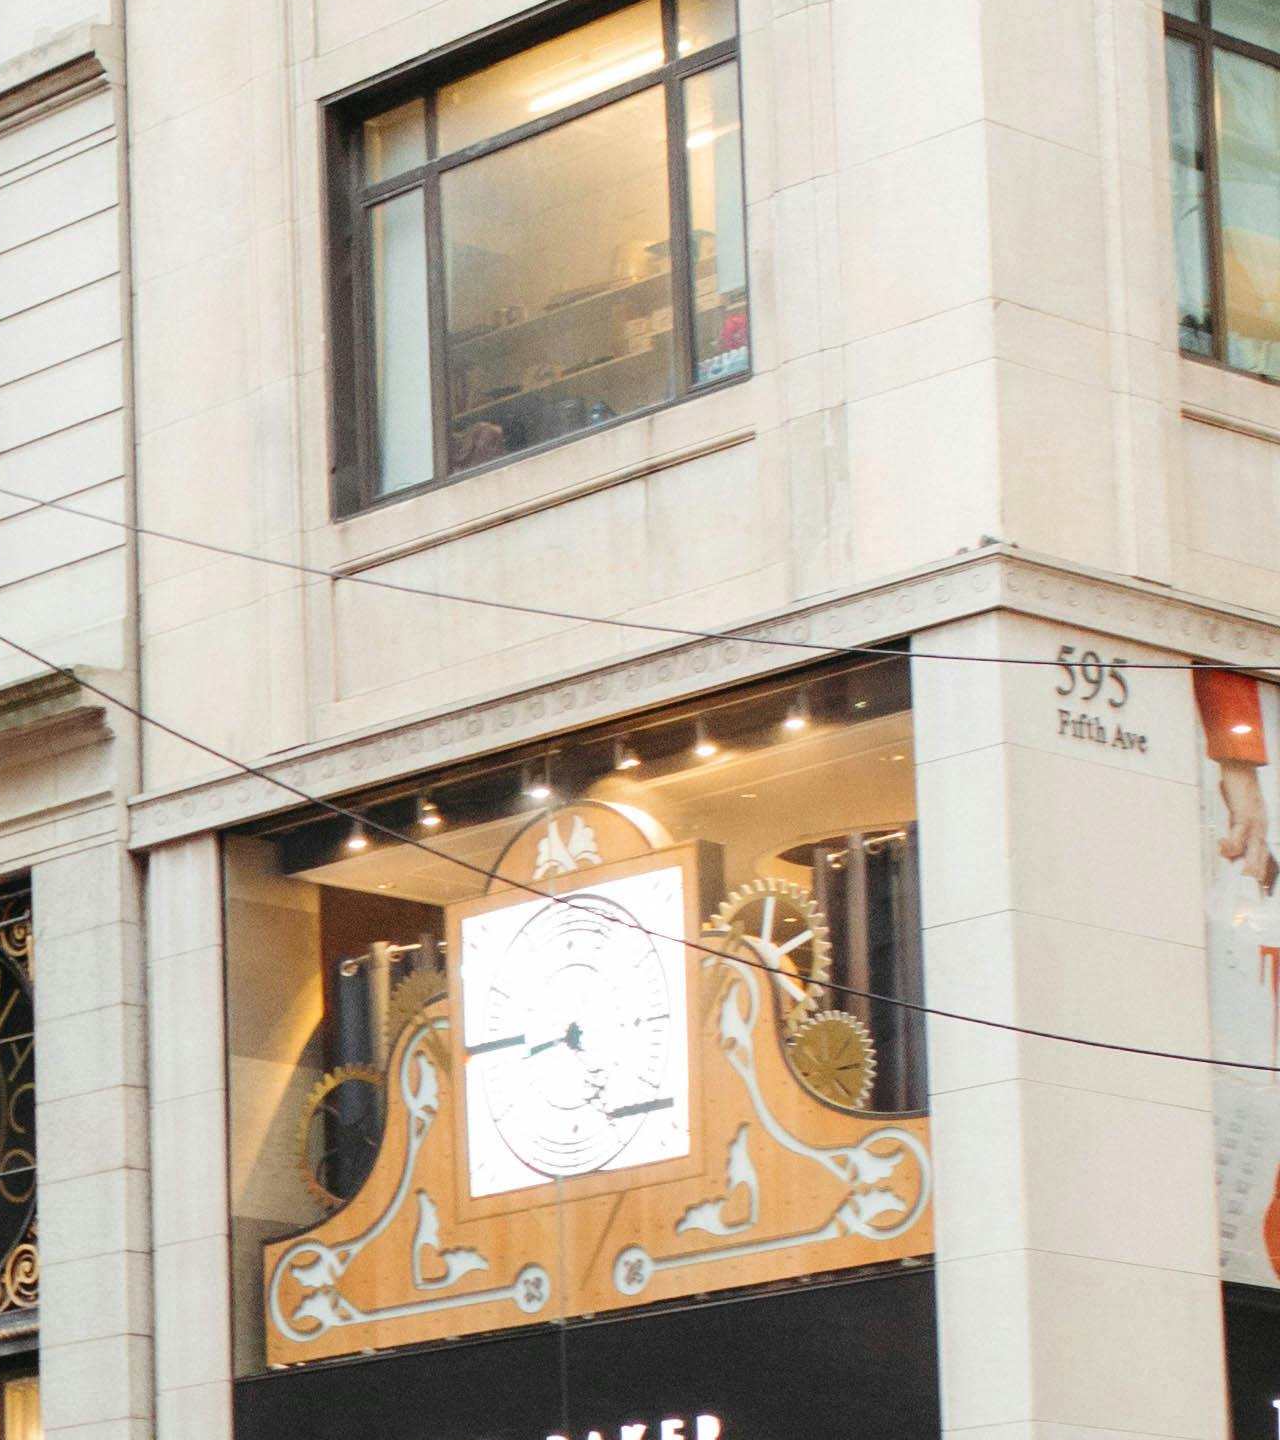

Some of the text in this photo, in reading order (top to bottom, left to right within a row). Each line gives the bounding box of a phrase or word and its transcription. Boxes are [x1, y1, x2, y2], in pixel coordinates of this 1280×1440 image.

[1056, 645, 1128, 708] 595
[1058, 708, 1148, 752] Fifth Ave
